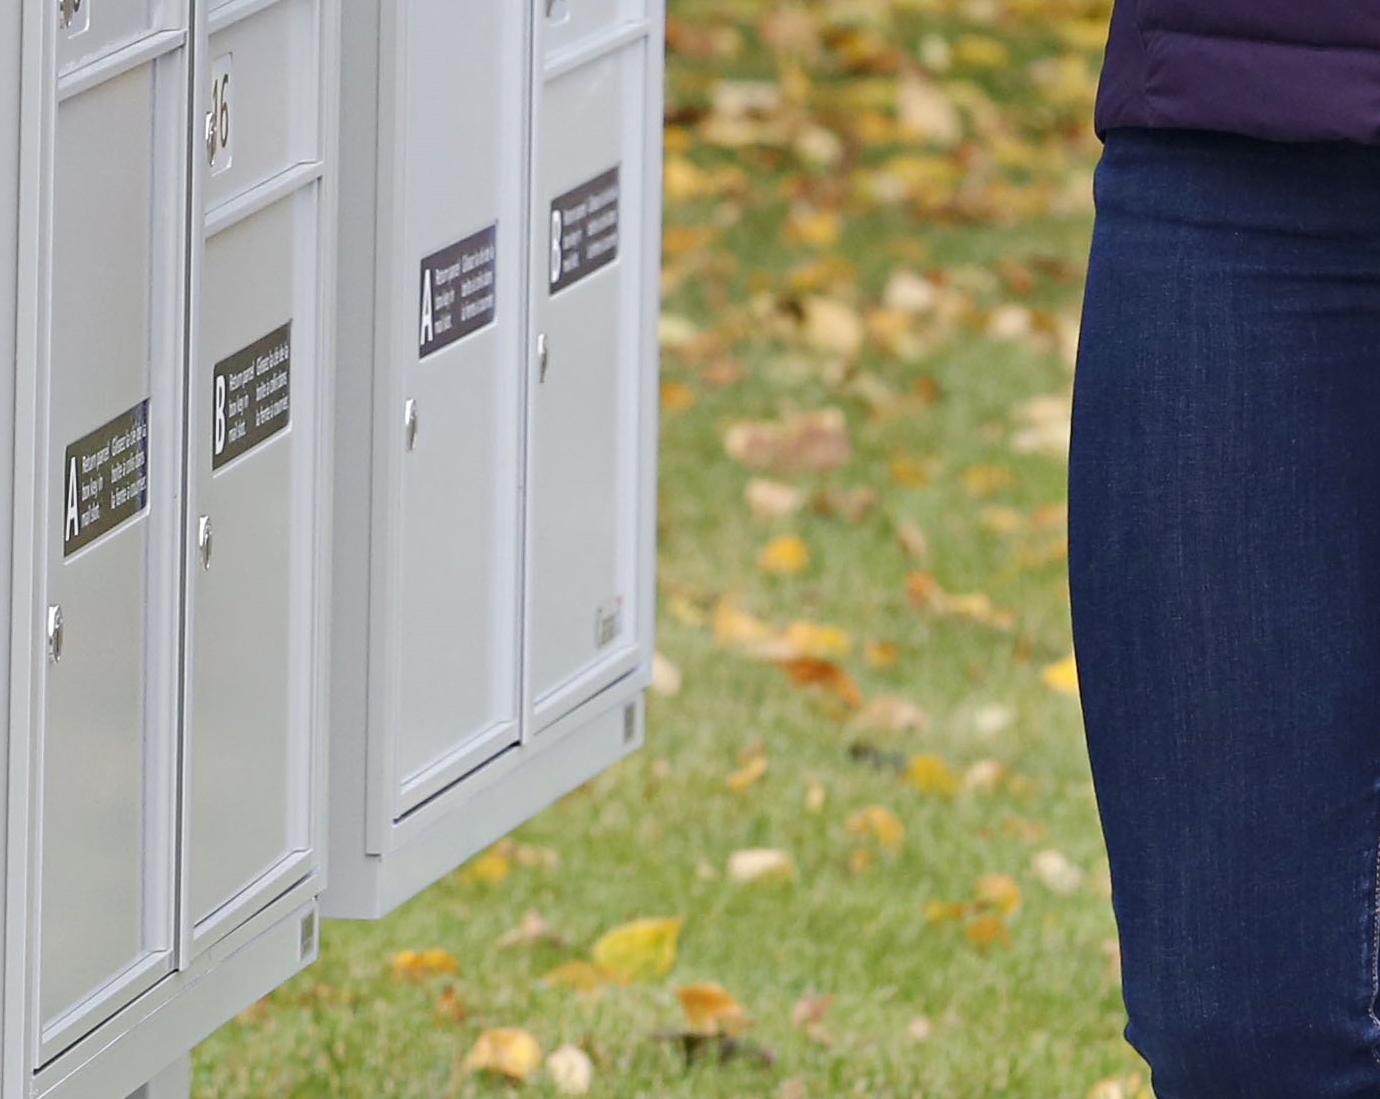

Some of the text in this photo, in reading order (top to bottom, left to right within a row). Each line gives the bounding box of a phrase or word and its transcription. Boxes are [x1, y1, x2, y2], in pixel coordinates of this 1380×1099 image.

[213, 74, 228, 149] 16
[551, 209, 562, 283] B
[421, 268, 433, 345] A
[215, 375, 226, 455] B
[66, 456, 79, 542] A
